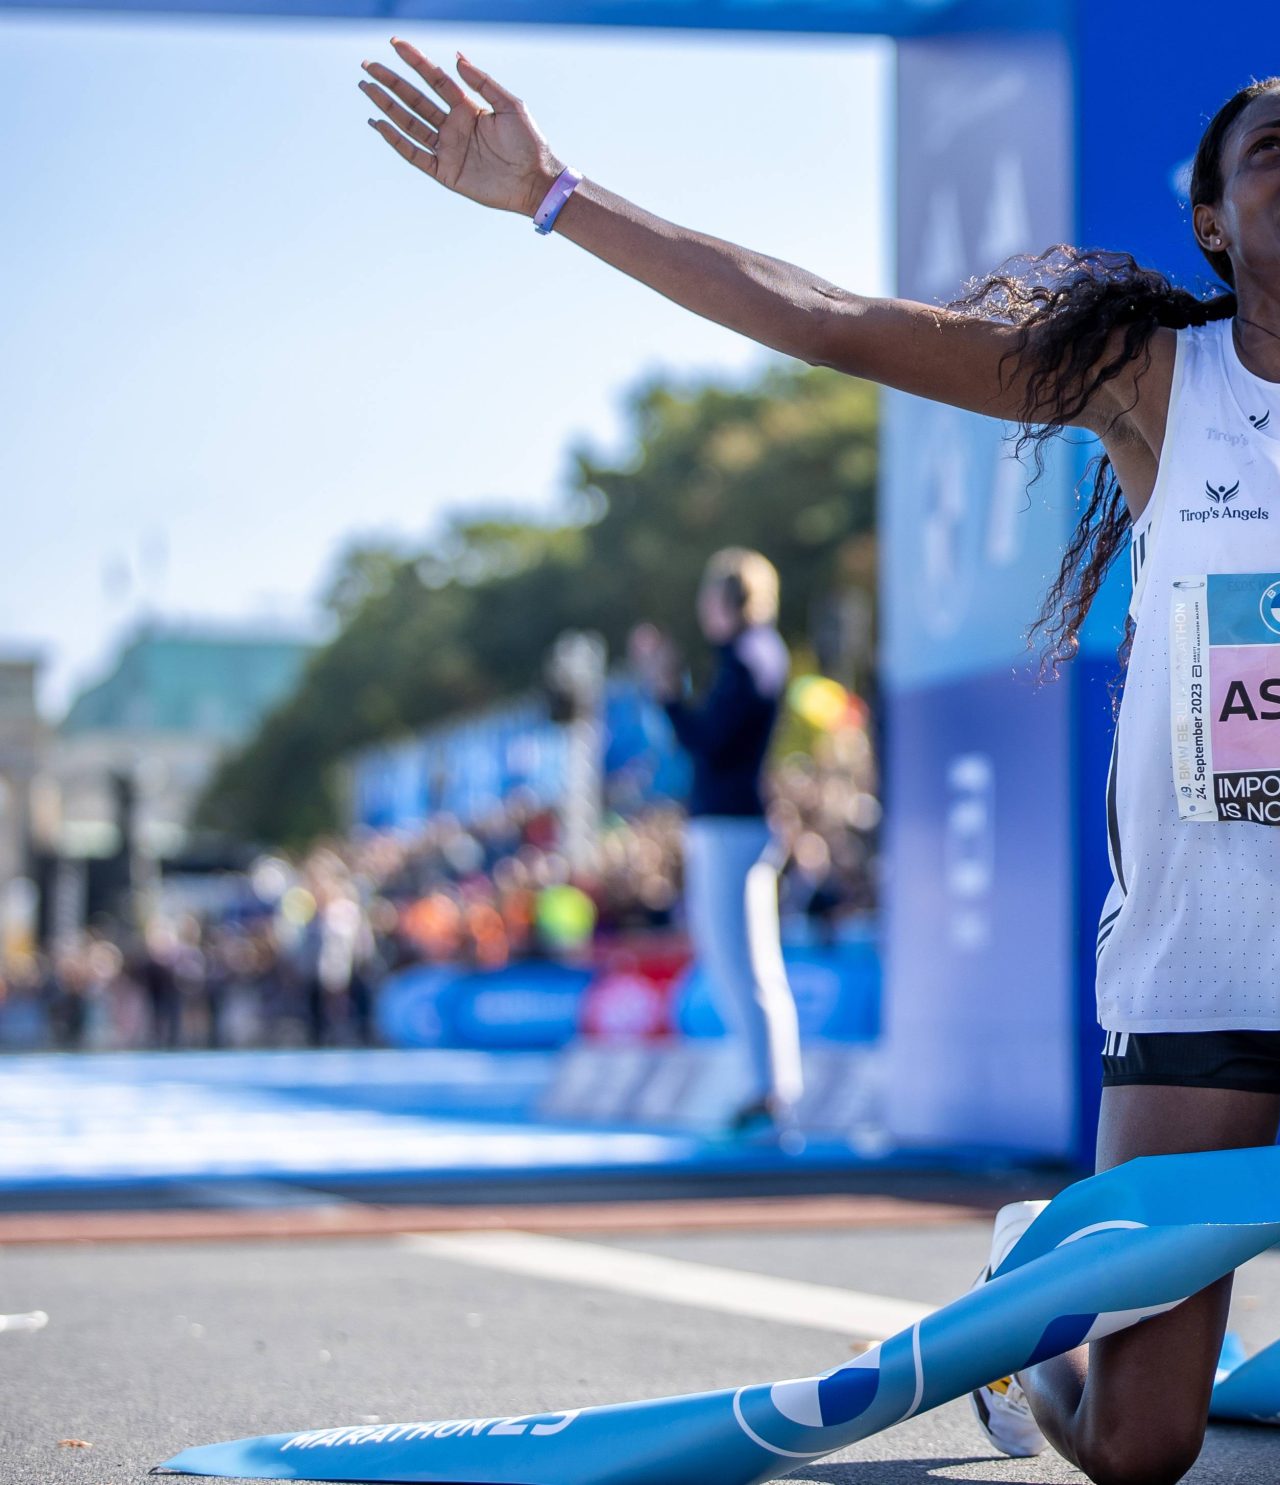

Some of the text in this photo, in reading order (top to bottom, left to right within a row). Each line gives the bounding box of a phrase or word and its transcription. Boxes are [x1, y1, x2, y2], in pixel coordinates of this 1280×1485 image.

[1180, 506, 1269, 522] Tirop's Angels
[1190, 683, 1207, 800] 24. September 2023
[1178, 746, 1191, 781] BMW
[1220, 802, 1242, 819] IS
[280, 1417, 498, 1451] MARATHON
